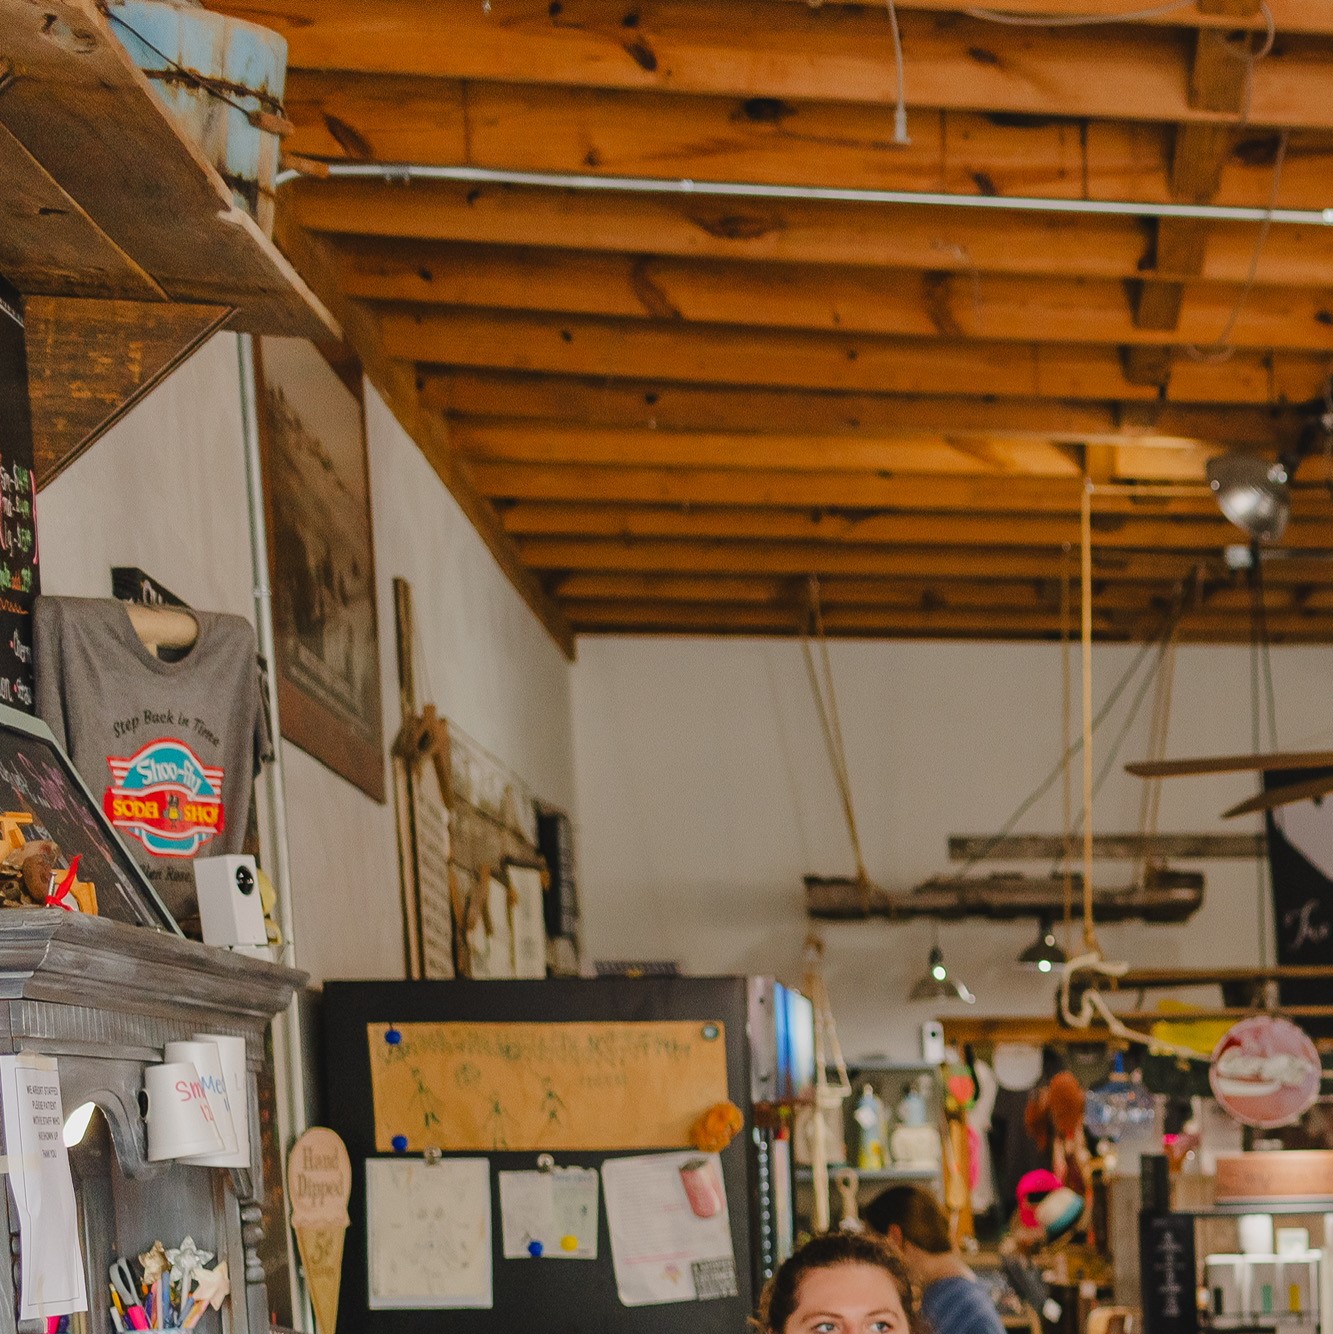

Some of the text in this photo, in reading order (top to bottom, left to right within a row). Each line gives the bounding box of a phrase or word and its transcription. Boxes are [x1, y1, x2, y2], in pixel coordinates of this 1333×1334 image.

[113, 717, 139, 738] Step
[143, 709, 174, 725] Back
[113, 799, 159, 819] SODA
